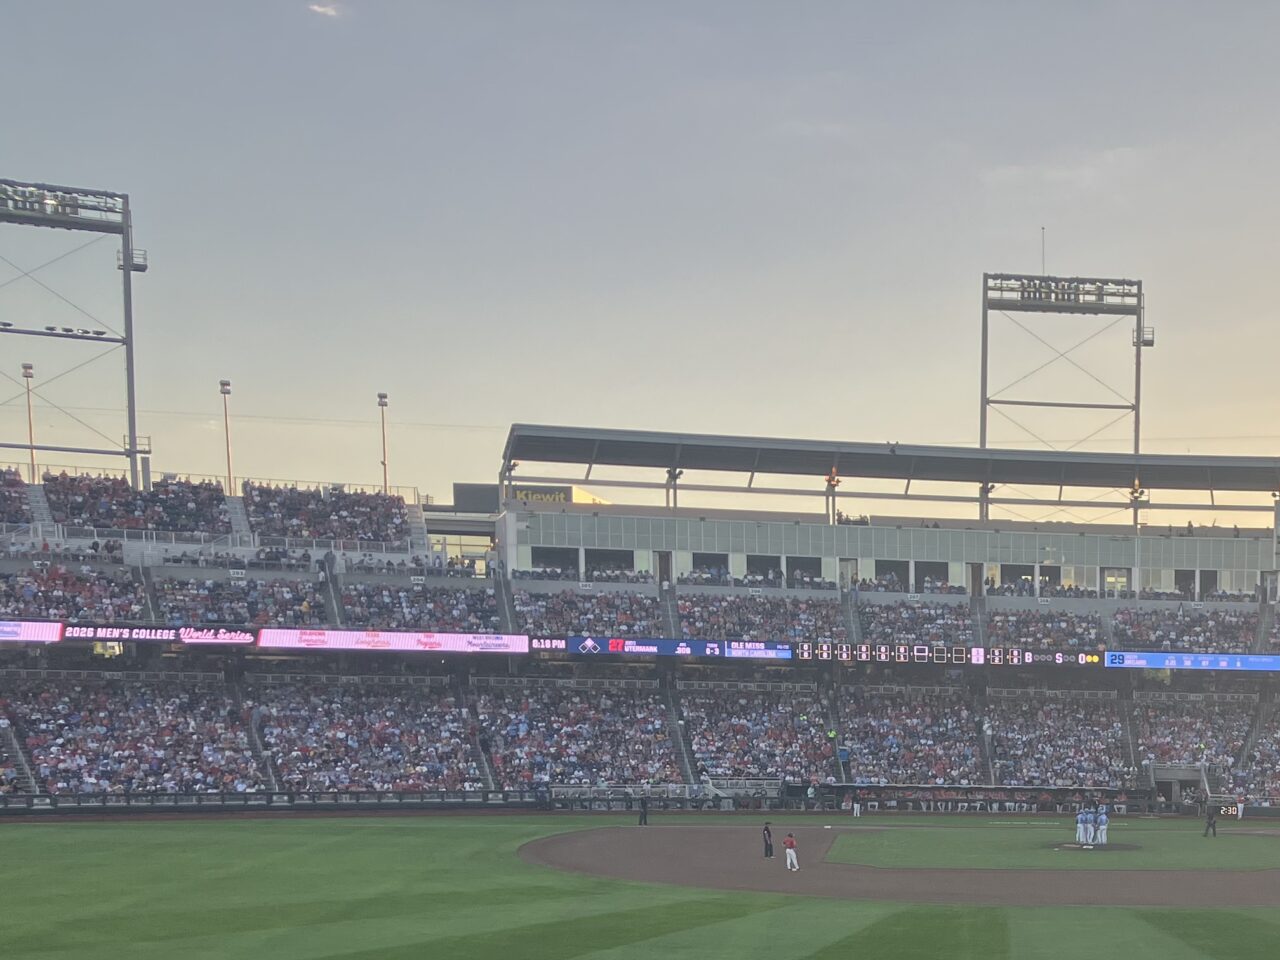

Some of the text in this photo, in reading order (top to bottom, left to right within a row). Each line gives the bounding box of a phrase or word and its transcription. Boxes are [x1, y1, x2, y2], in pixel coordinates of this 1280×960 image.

[516, 490, 566, 503] Kiewit
[65, 627, 254, 642] 2026 MEN'S COLLEGE World Series
[552, 640, 566, 648] PM
[608, 639, 624, 652] 27
[1025, 652, 1032, 662] B
[1056, 653, 1063, 663] S
[1078, 654, 1086, 664] O
[1110, 654, 1124, 664] 29
[1220, 806, 1237, 815] 2:30
